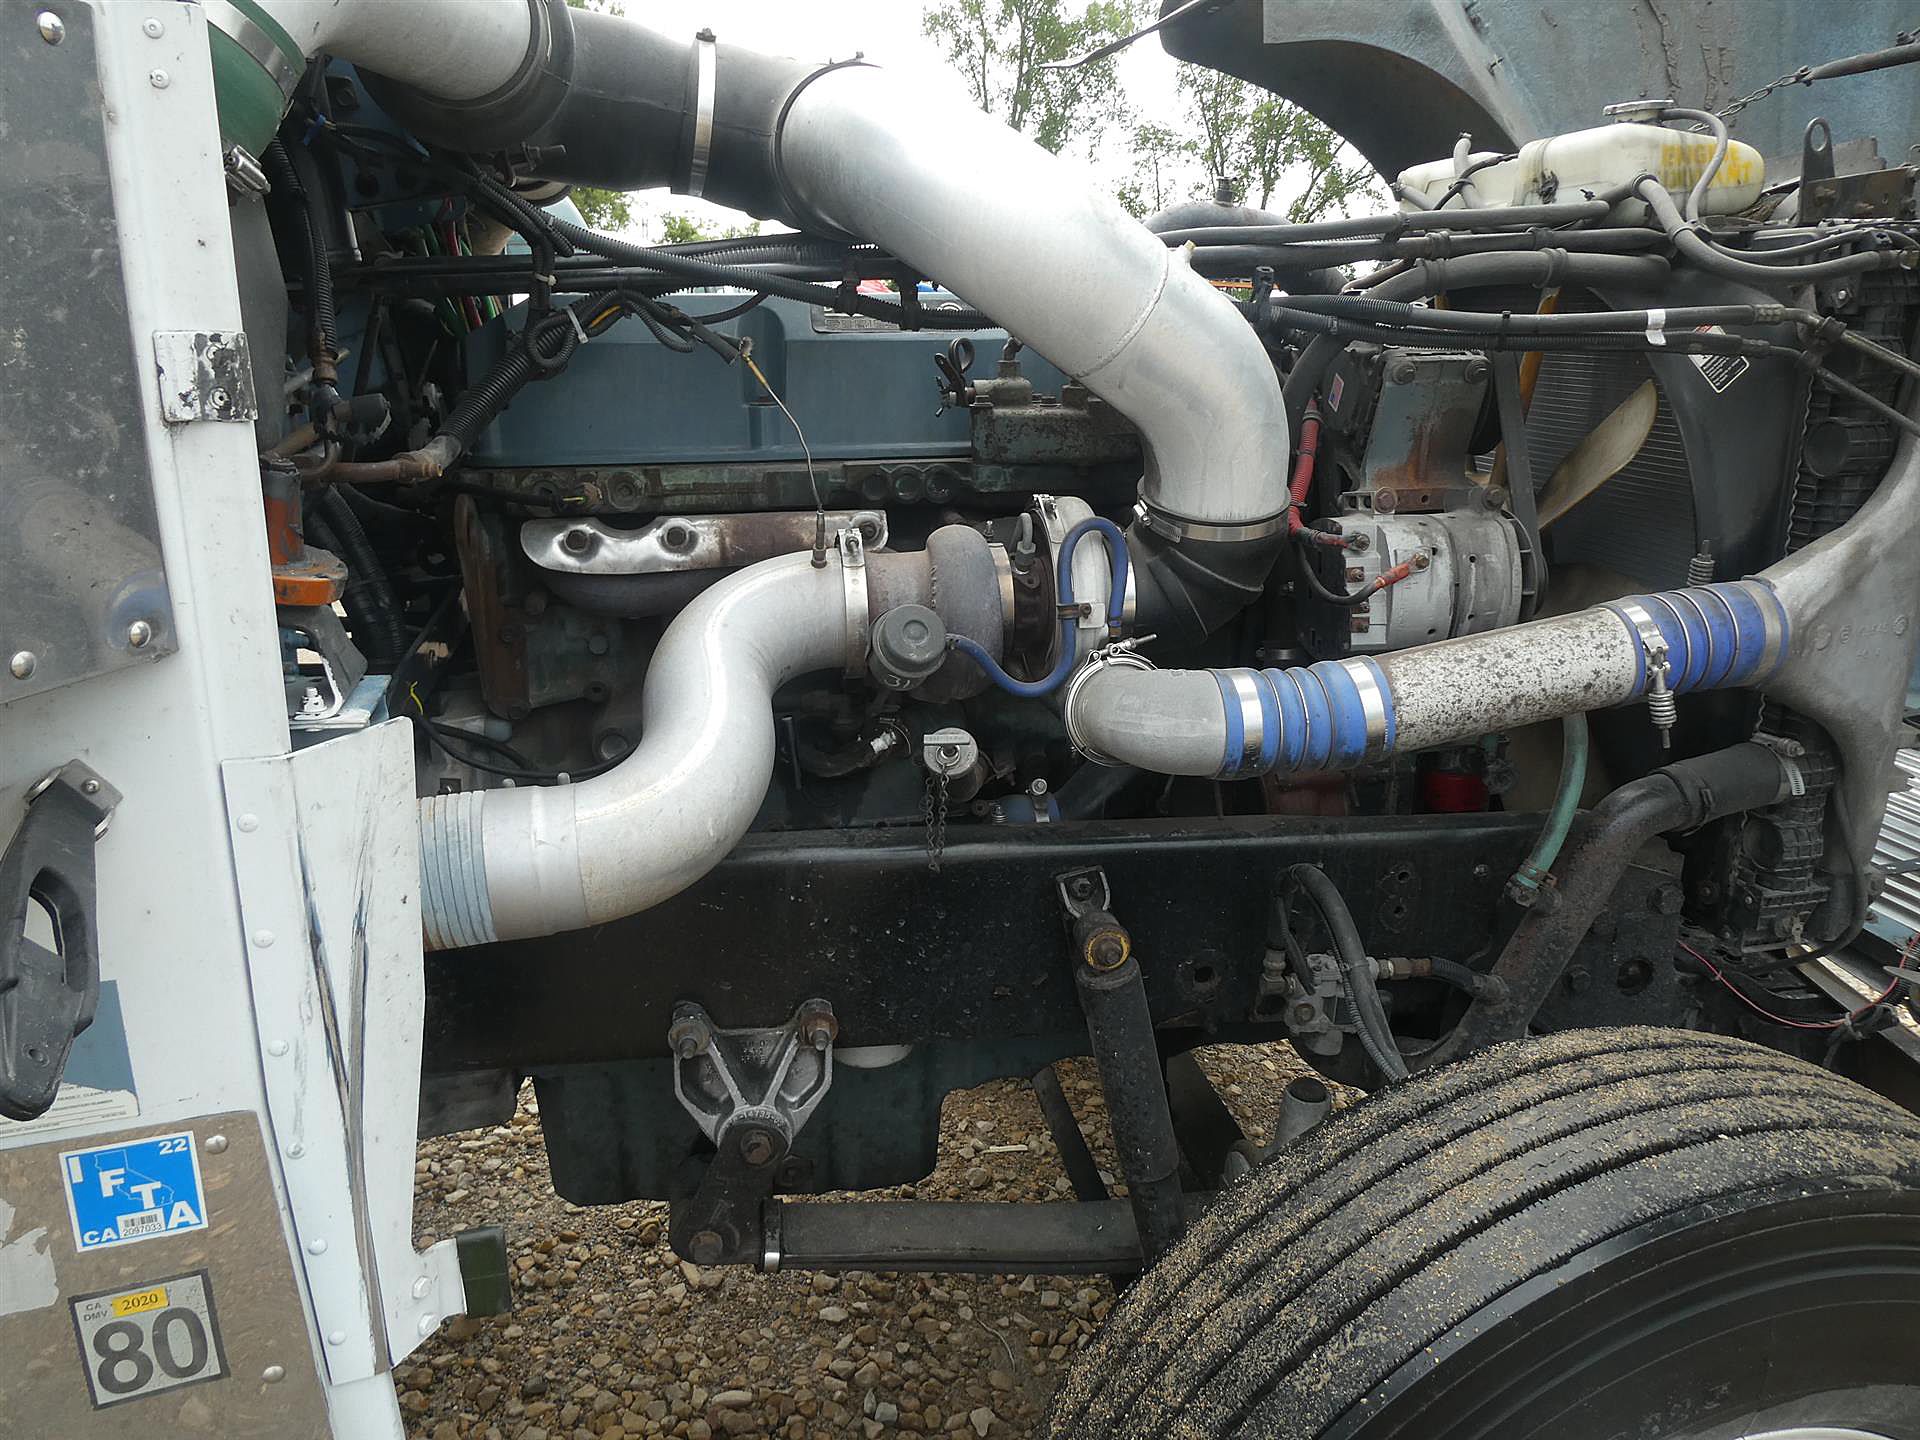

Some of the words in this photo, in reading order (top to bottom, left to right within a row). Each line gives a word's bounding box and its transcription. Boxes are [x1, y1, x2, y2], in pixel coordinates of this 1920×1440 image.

[1662, 144, 1740, 166] ENGIE
[158, 1138, 188, 1155] 22
[82, 1227, 119, 1244] CA
[86, 1302, 101, 1311] CA
[121, 1293, 159, 1311] 2020
[83, 1310, 108, 1322] DMV
[93, 1307, 209, 1394] 80
